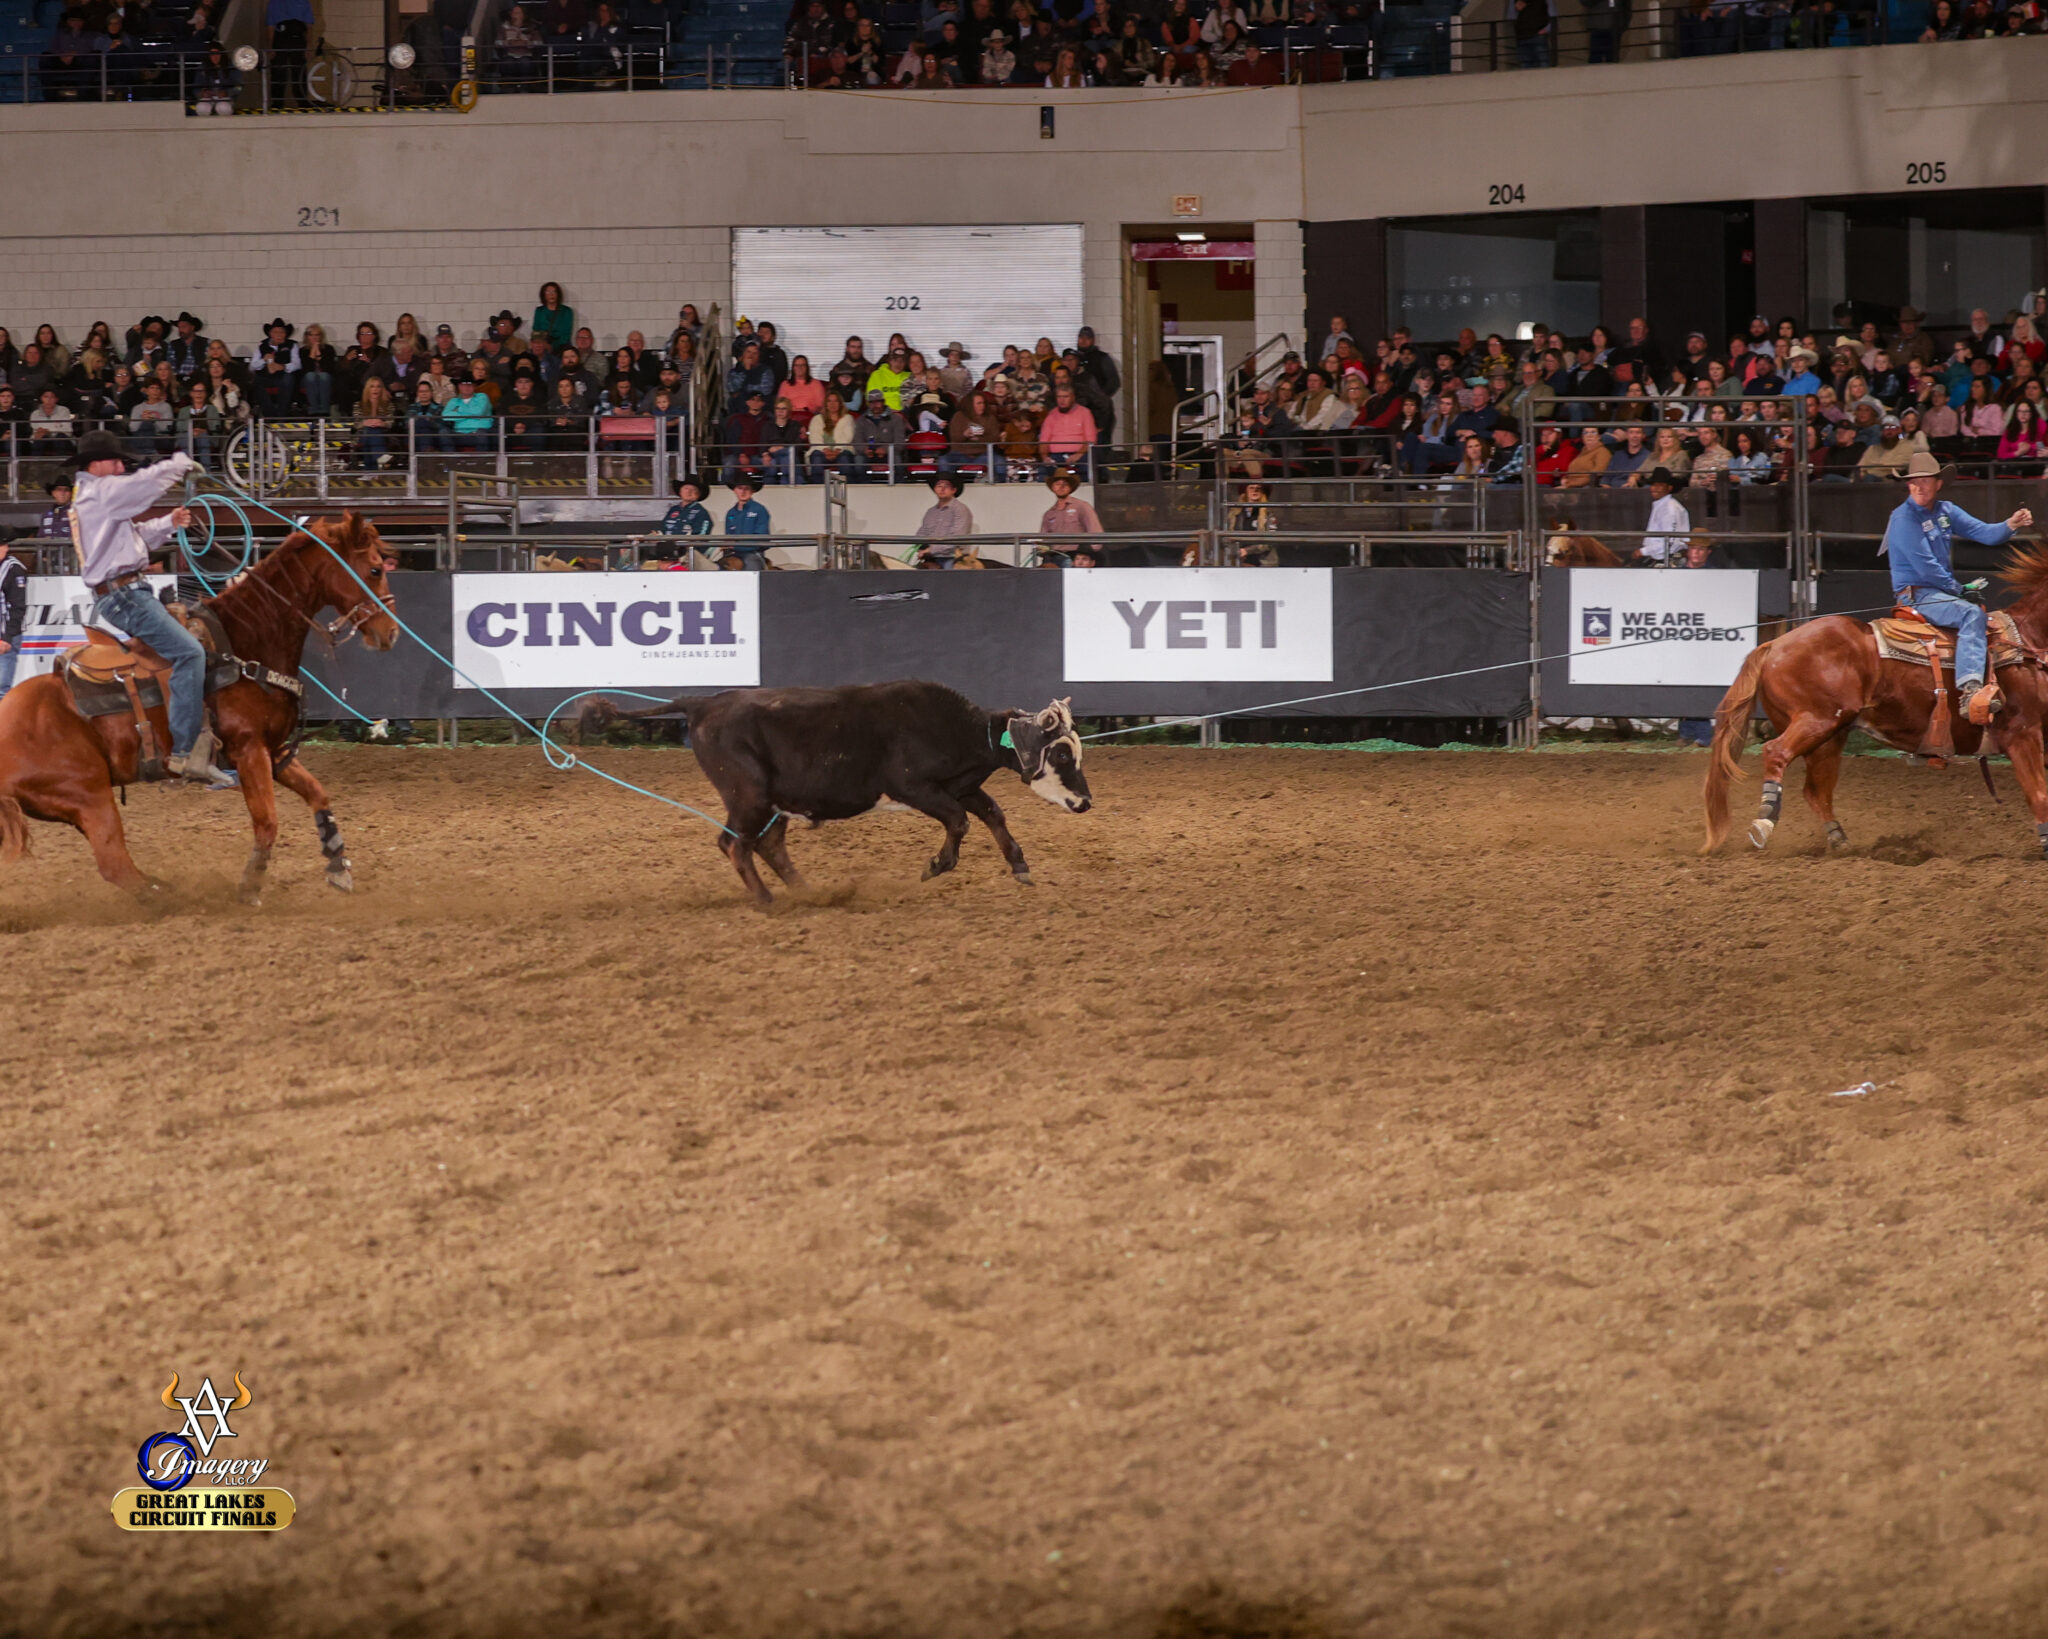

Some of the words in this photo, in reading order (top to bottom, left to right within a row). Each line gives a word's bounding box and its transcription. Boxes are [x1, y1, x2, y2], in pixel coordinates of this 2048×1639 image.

[1906, 161, 1947, 184] 205
[1489, 183, 1526, 205] 204
[297, 206, 340, 227] 201
[1183, 243, 1208, 255] Exit
[885, 295, 921, 310] 202
[1111, 599, 1278, 649] YETI
[1622, 612, 1657, 626] WE
[1661, 612, 1705, 626] ARE
[1621, 627, 1745, 642] PRORODEO.
[641, 650, 737, 659] CINCHJEANS.COM
